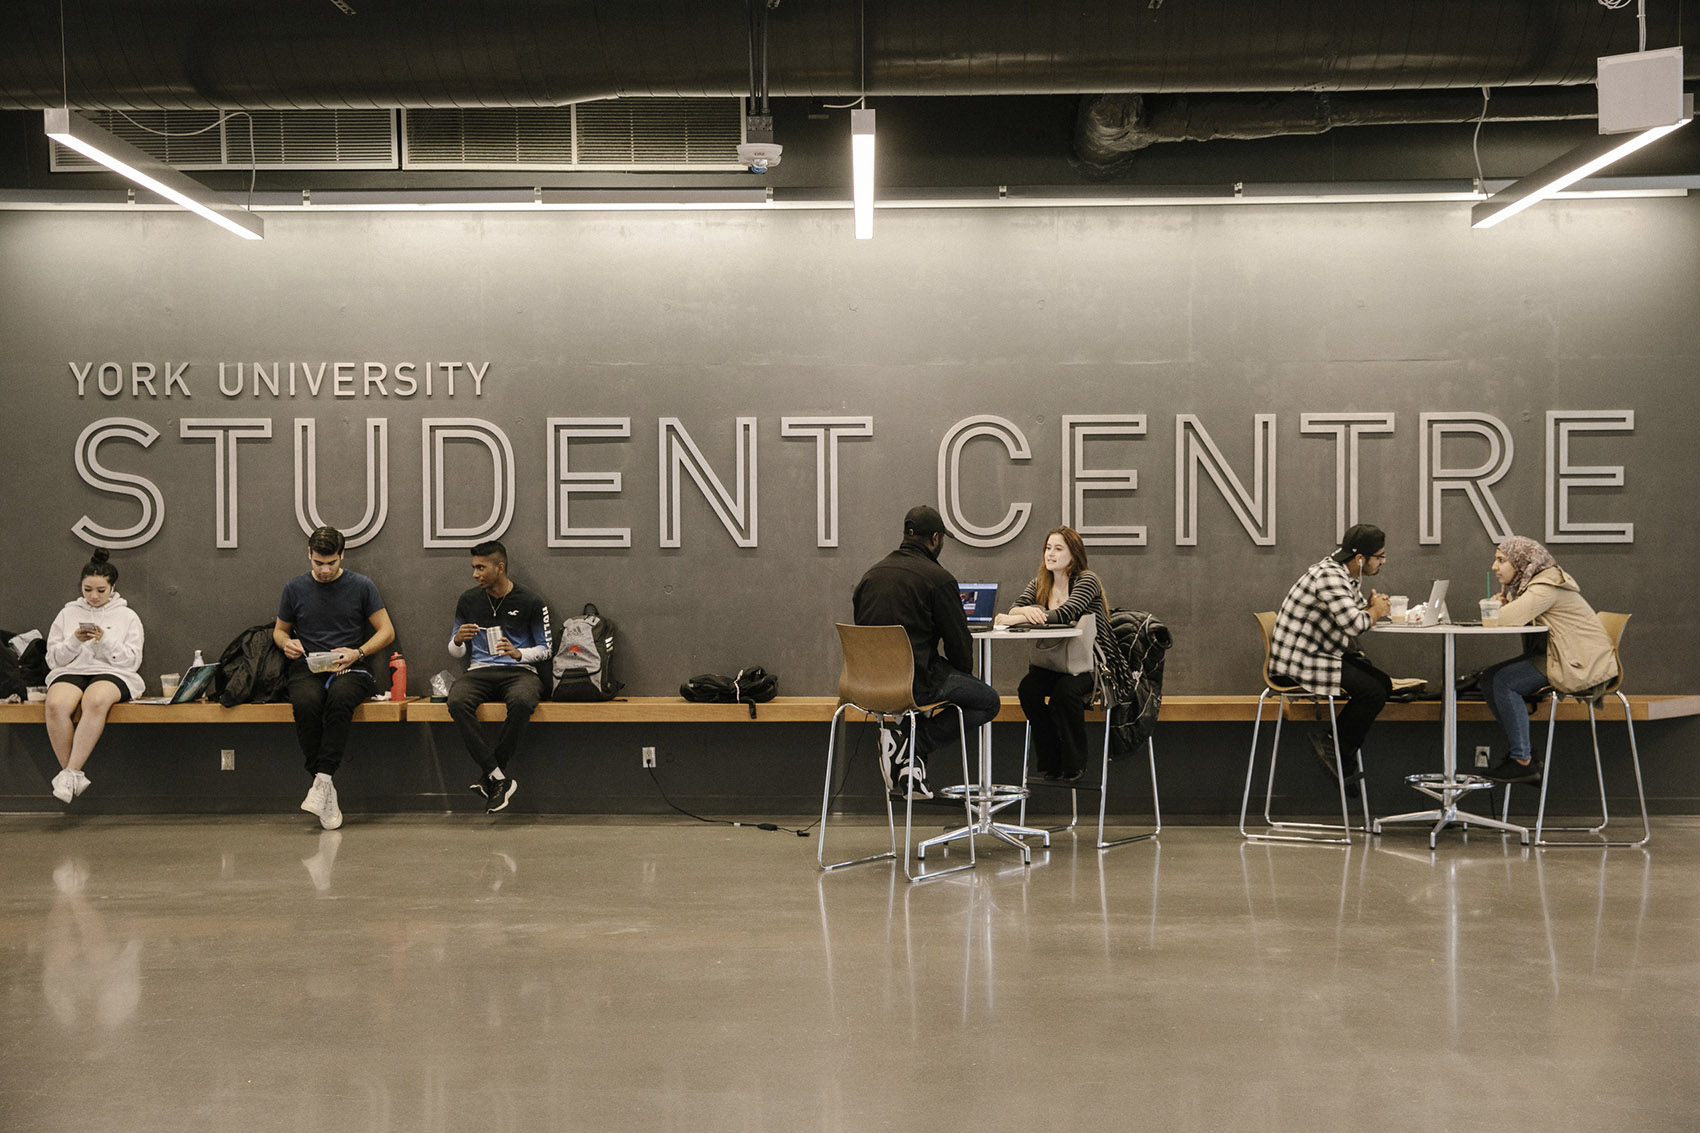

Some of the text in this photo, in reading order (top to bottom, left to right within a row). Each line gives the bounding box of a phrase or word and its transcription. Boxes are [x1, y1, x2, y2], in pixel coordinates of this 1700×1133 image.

[69, 362, 491, 397] YORK UNIVERSITY
[71, 410, 1634, 549] STUDENT CENTRE
